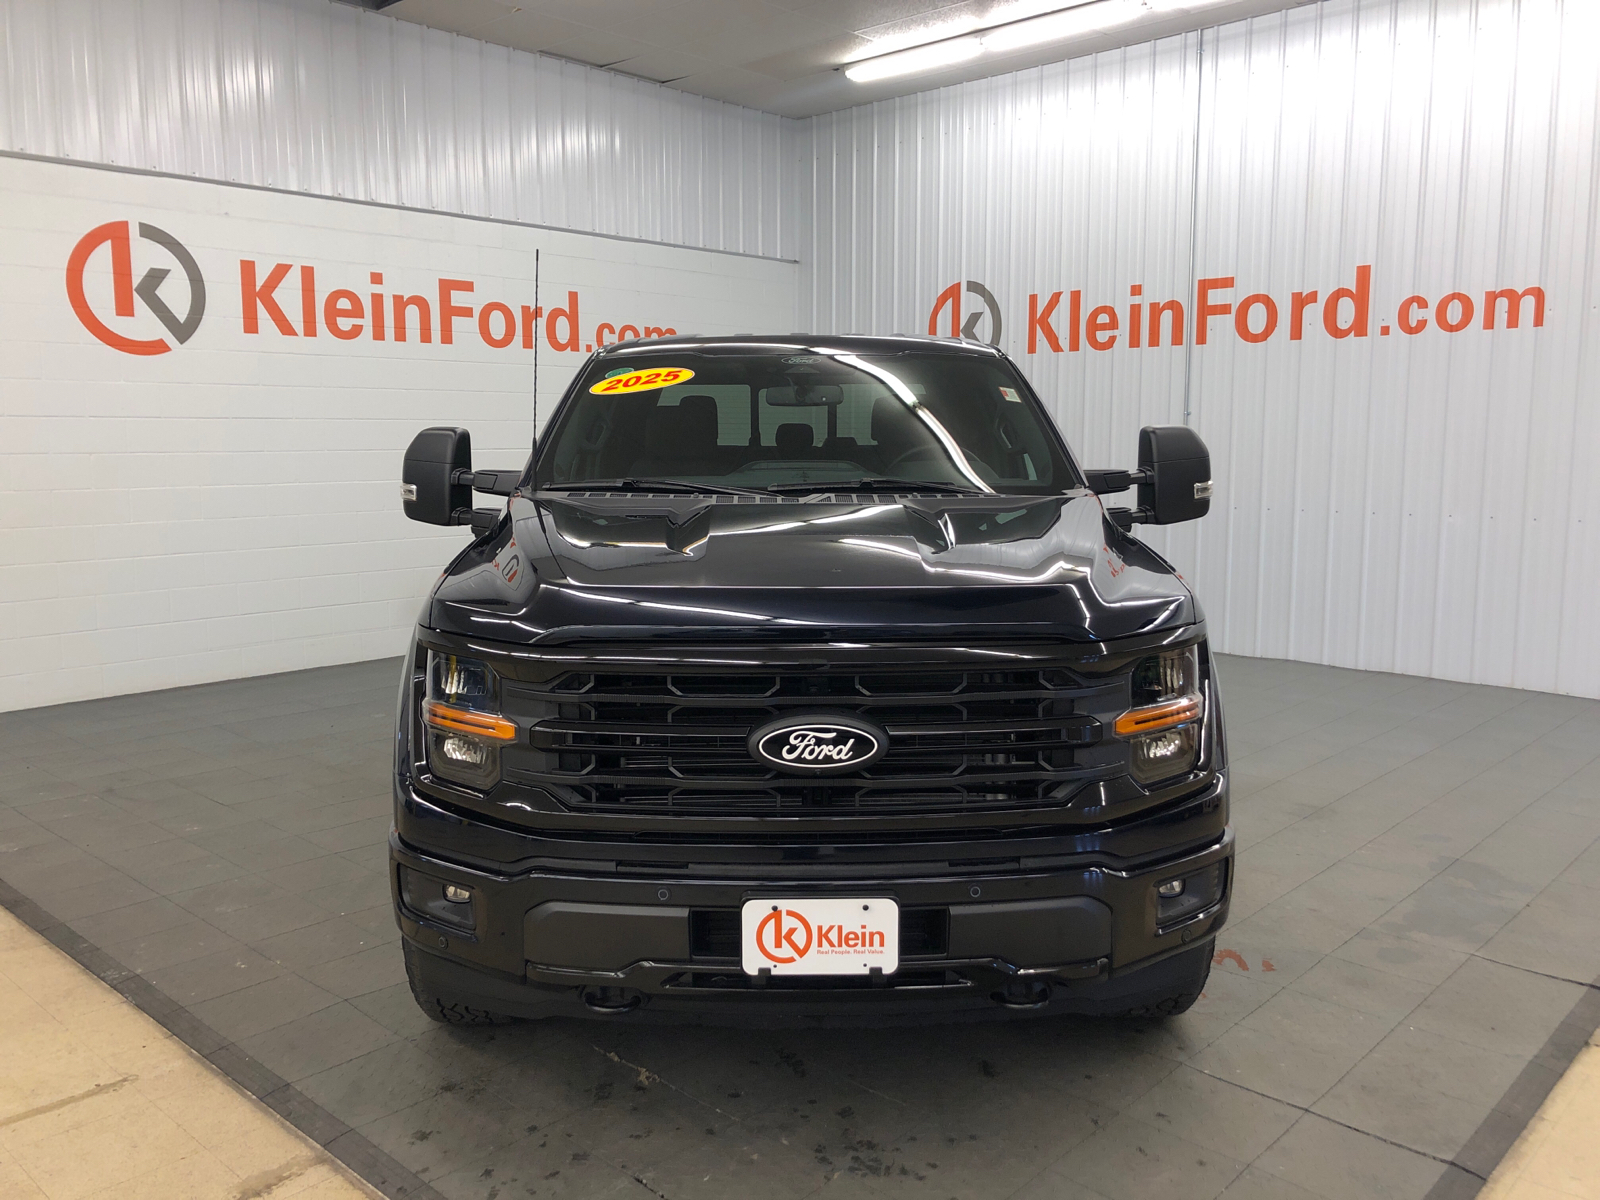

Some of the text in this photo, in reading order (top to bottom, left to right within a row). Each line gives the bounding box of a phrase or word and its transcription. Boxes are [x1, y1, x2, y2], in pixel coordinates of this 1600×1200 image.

[1027, 265, 1546, 354] KleinFord.com
[600, 369, 682, 393] 2025
[781, 730, 855, 760] Ford
[817, 925, 885, 948] Klein
[830, 948, 852, 956] People.
